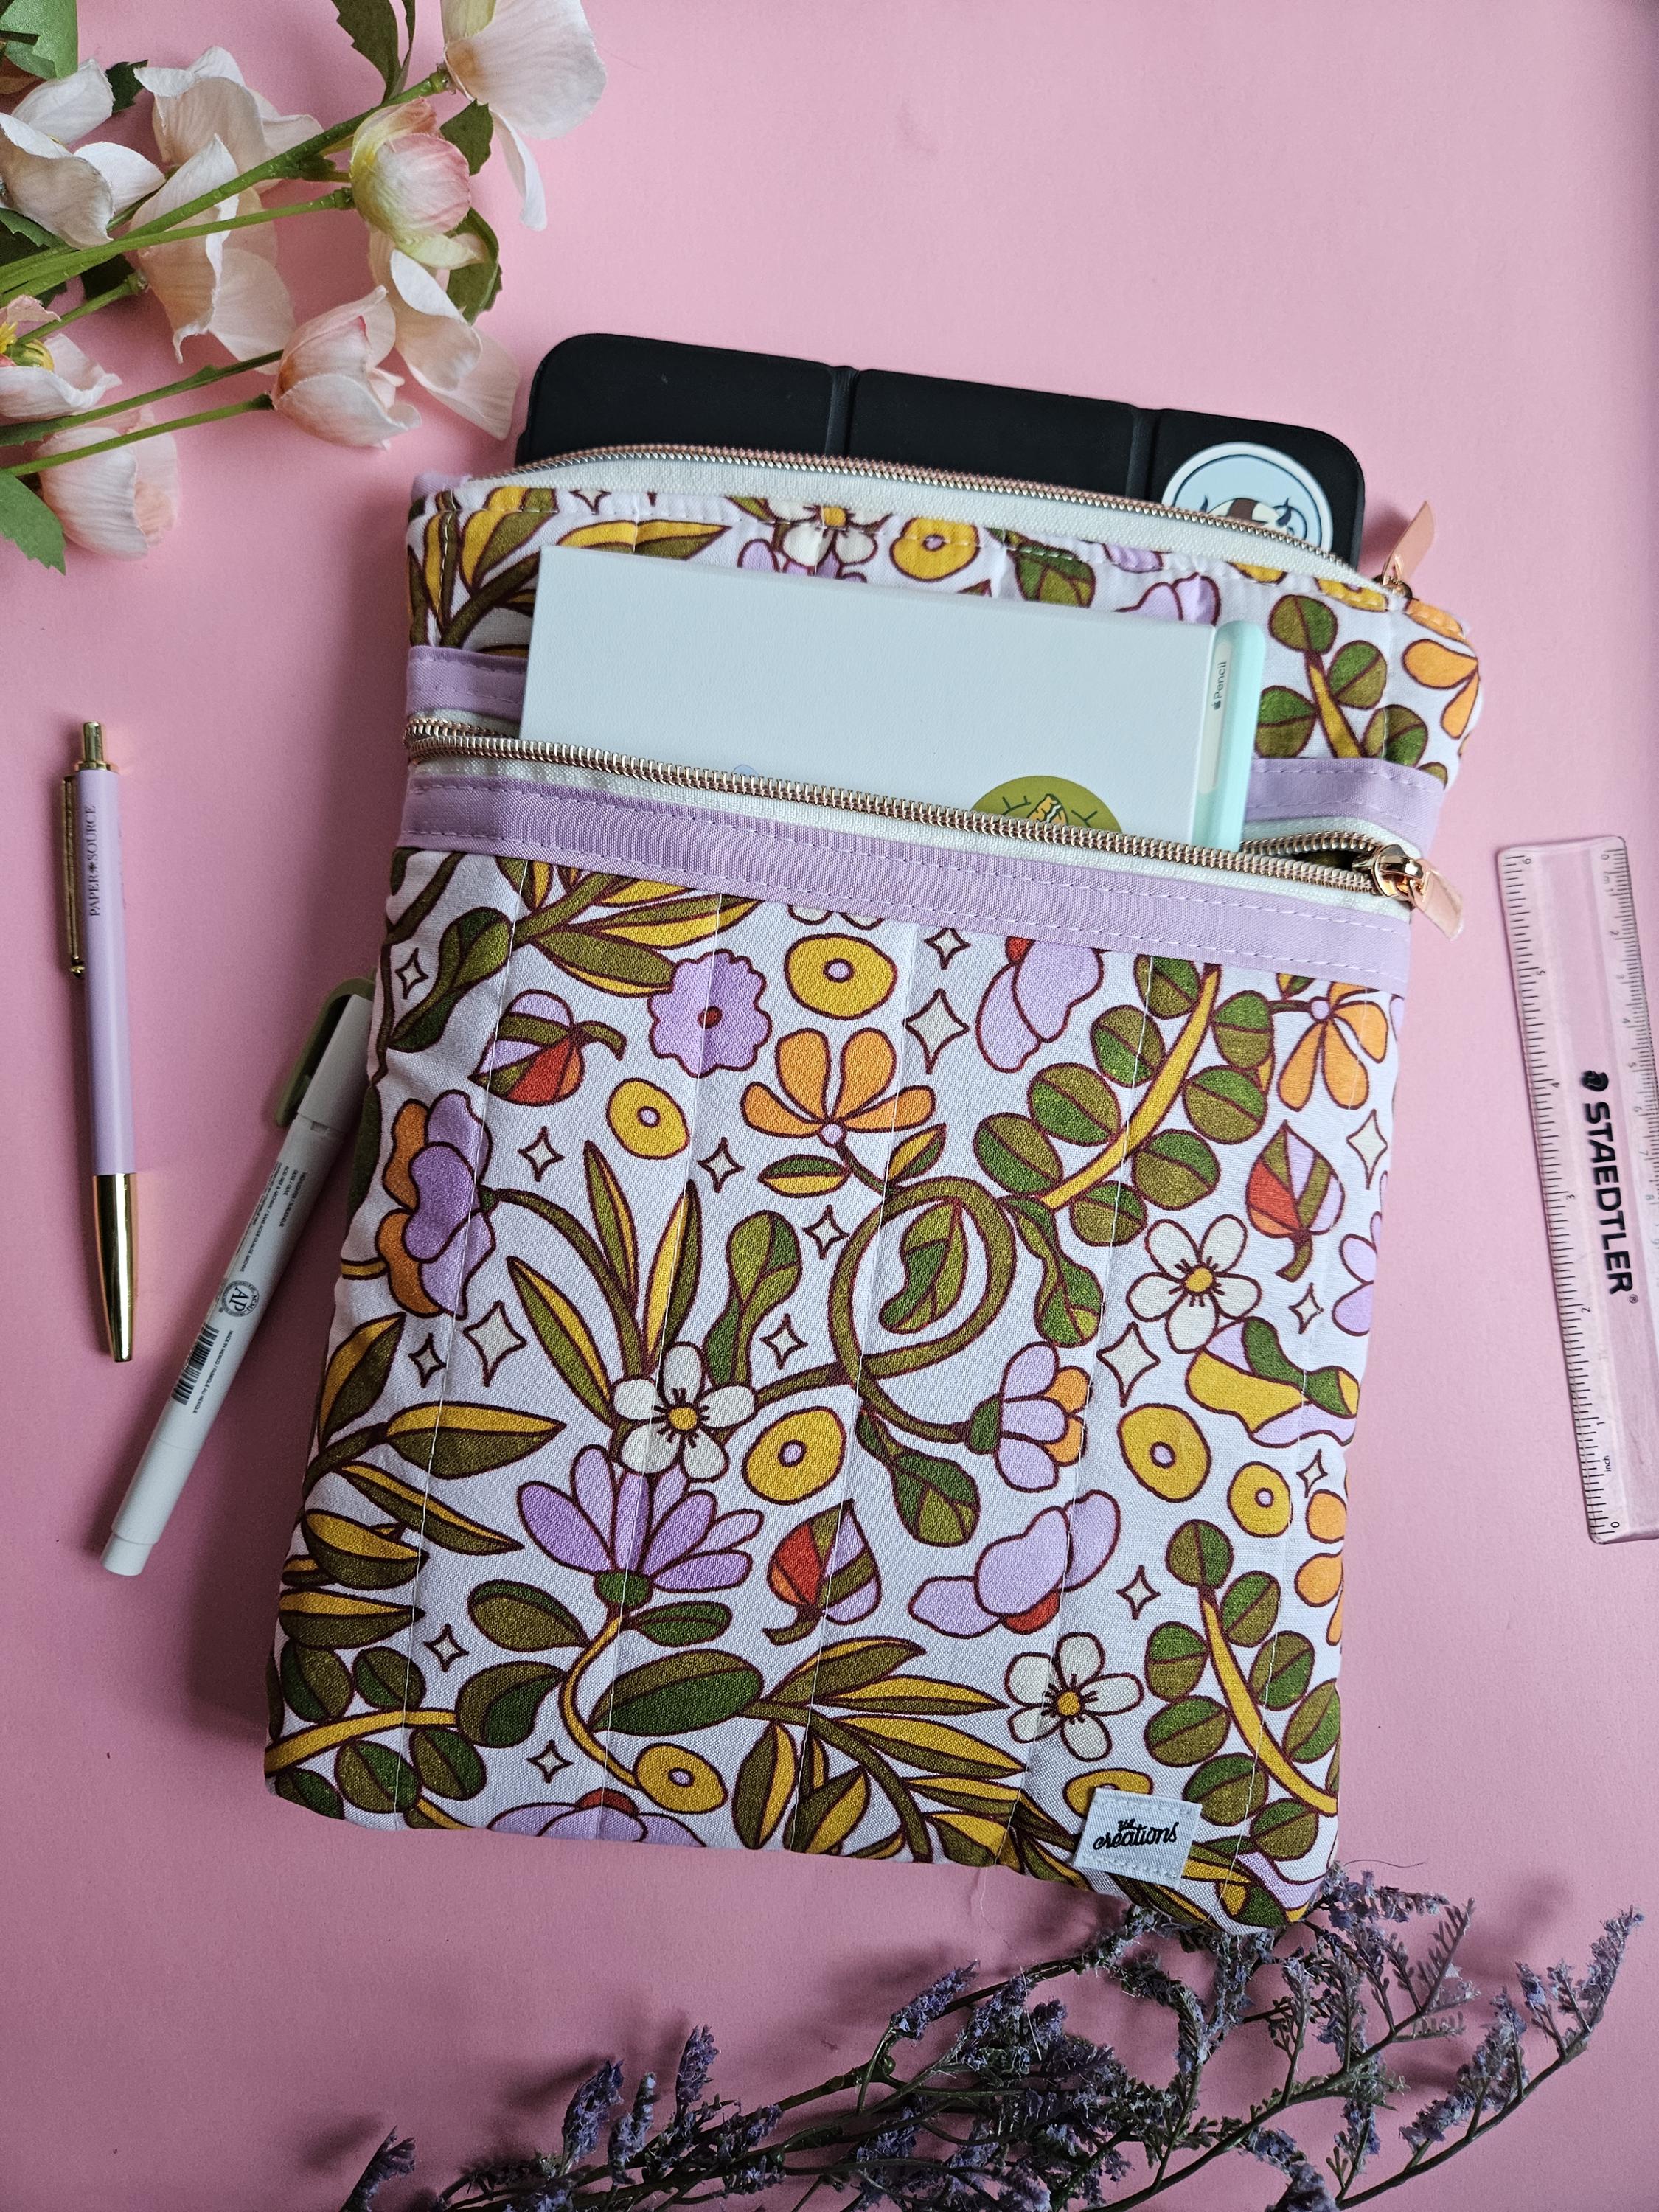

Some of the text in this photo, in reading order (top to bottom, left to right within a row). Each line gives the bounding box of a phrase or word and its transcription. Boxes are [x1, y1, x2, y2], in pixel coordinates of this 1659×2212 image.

[1214, 661, 1227, 699] Pencil
[85, 805, 101, 917] PAPER SOURCE
[229, 1287, 250, 1312] AP
[1604, 1455, 1612, 1473] inch
[1610, 1520, 1620, 1528] 0
